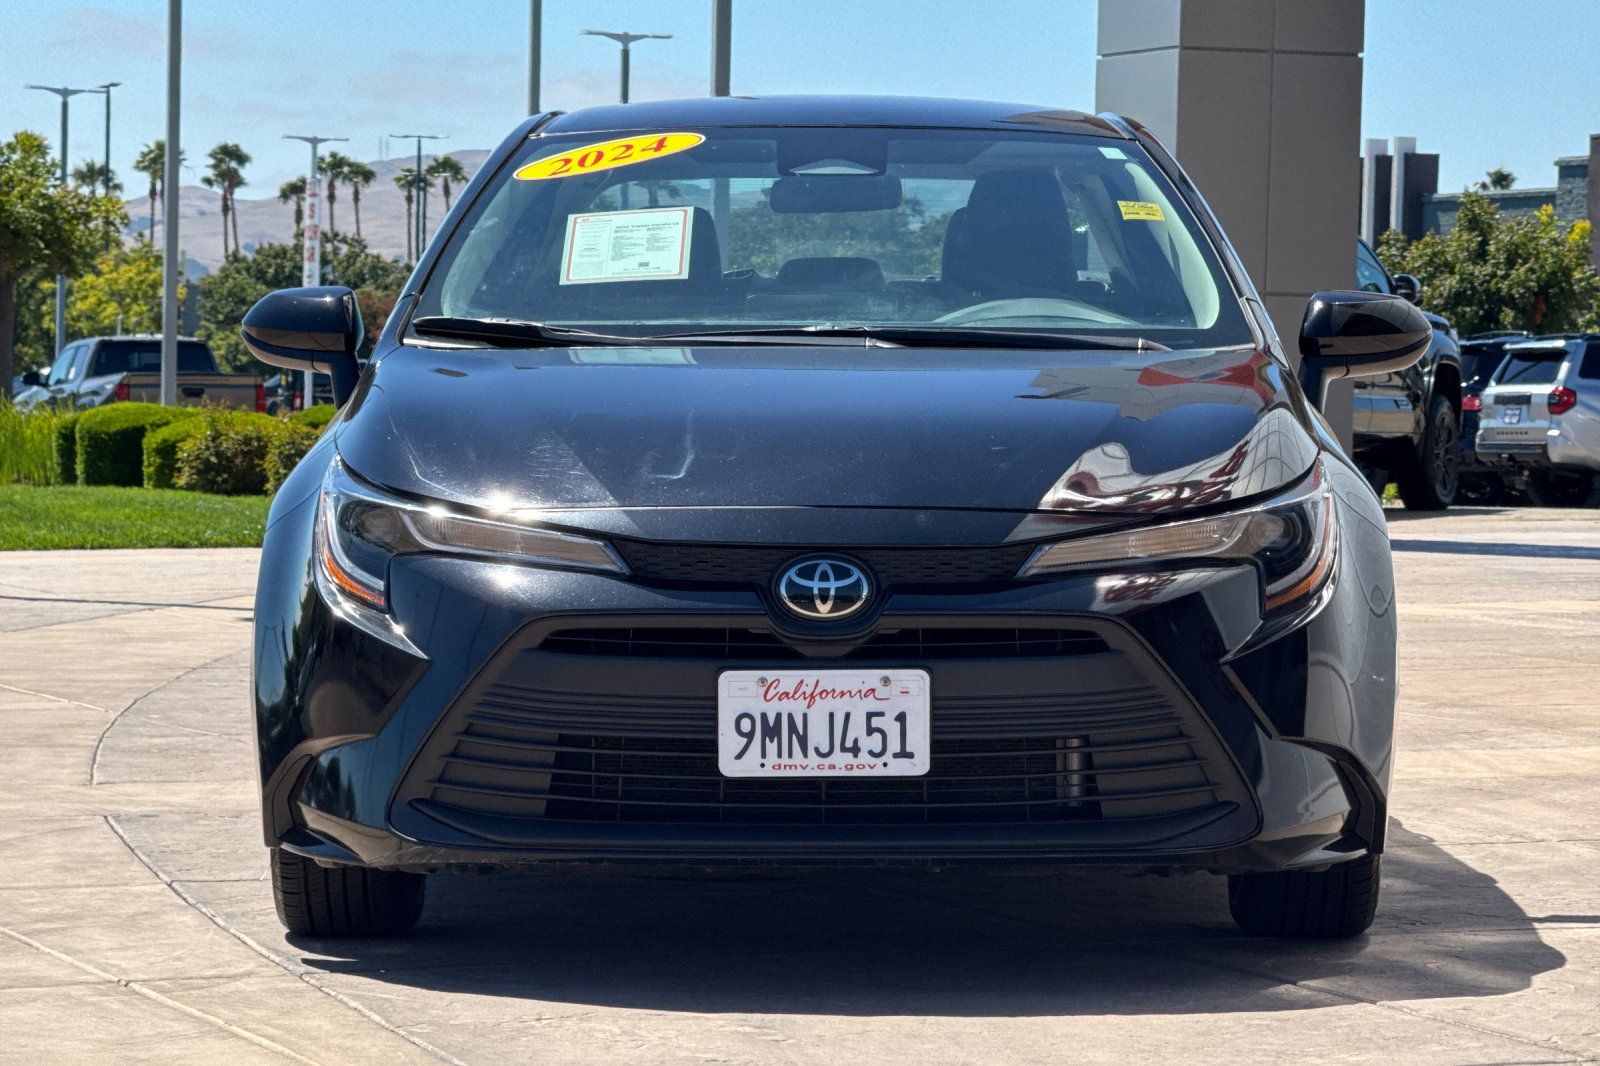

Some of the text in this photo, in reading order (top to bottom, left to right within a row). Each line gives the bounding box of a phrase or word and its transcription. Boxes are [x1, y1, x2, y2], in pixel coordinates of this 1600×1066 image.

[548, 136, 668, 177] 2024
[763, 678, 890, 709] California
[733, 711, 915, 760] 9MNJ451
[771, 762, 877, 771] dmv.ca.gov
